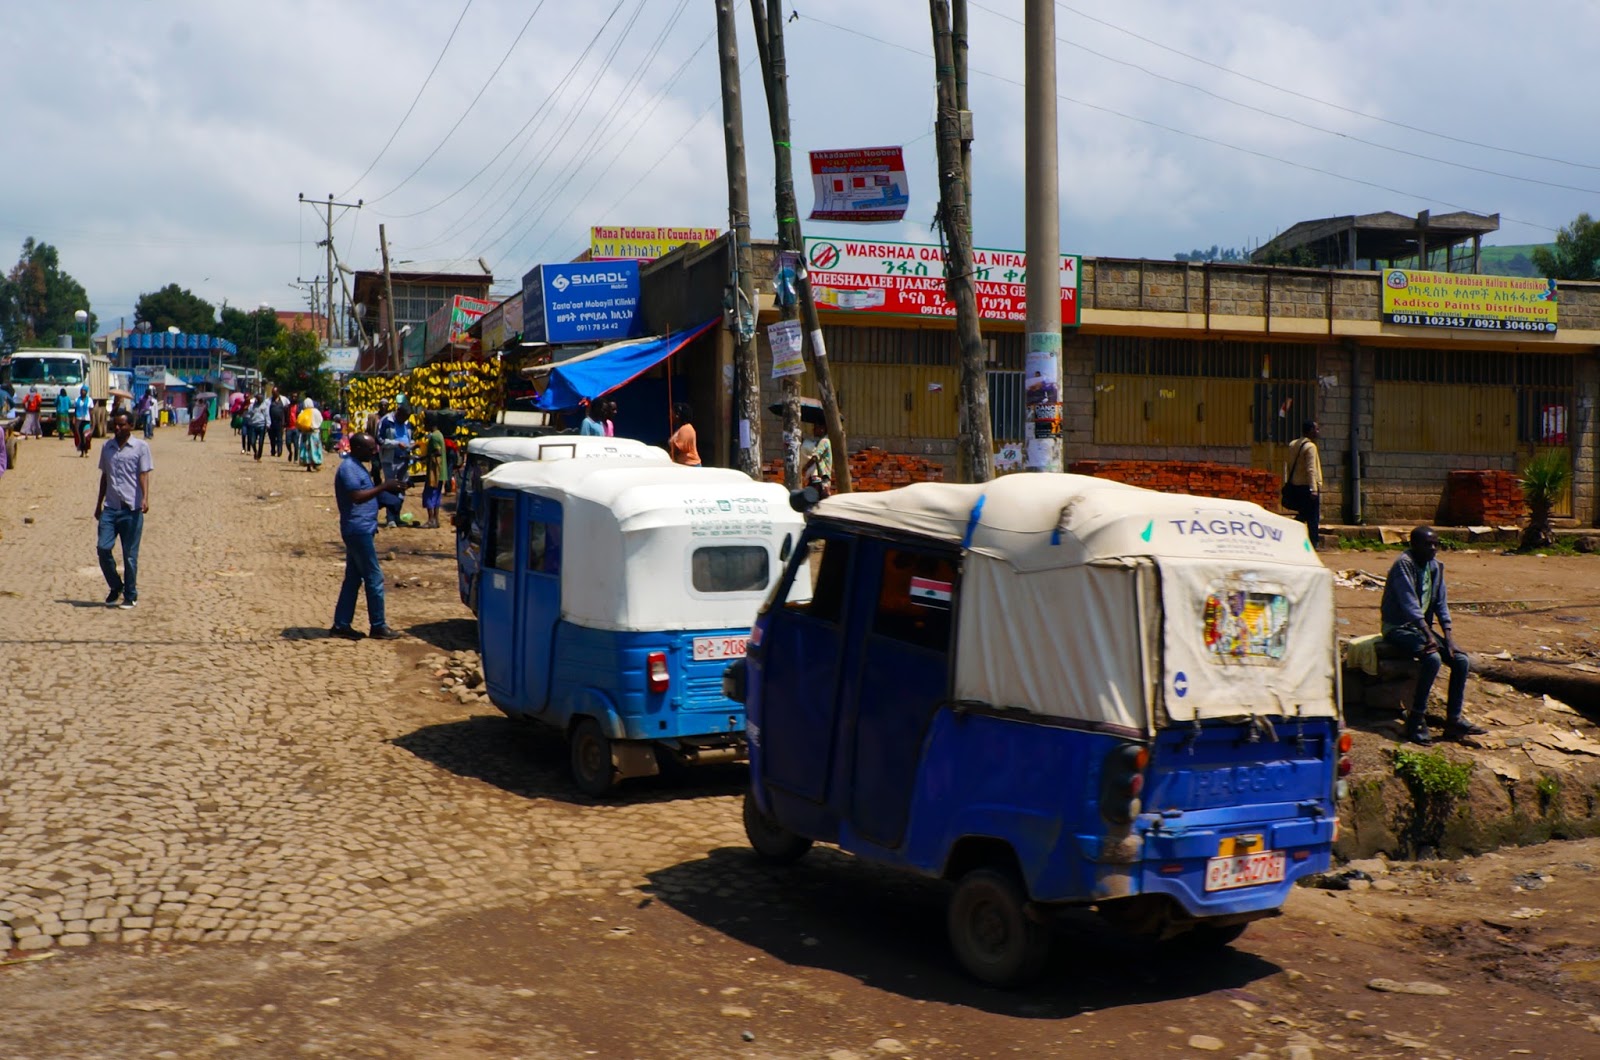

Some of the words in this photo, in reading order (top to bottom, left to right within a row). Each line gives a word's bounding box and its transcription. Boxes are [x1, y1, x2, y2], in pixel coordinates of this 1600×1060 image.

[595, 227, 618, 239] Mana
[657, 228, 665, 239] Fi
[667, 228, 702, 241] Cuunfaa
[704, 229, 717, 241] AM
[593, 244, 614, 256] A.M
[845, 243, 915, 260] WARSHAA
[882, 260, 928, 276] ንፋስ
[571, 272, 627, 284] SMADL
[810, 273, 893, 288] MEESHAALEE
[975, 283, 1007, 295] NAAS
[921, 306, 942, 315] 0911
[985, 310, 1006, 319] 0913
[1393, 298, 1439, 308] Kadisco
[1445, 301, 1480, 311] Paints
[1486, 303, 1549, 315] Distributor
[1393, 315, 1421, 324] 0911
[1425, 316, 1465, 327] 102345
[1475, 320, 1501, 329] 0921
[1505, 321, 1545, 331] 304650
[1169, 519, 1282, 542] TAGROW
[723, 639, 749, 656] 208
